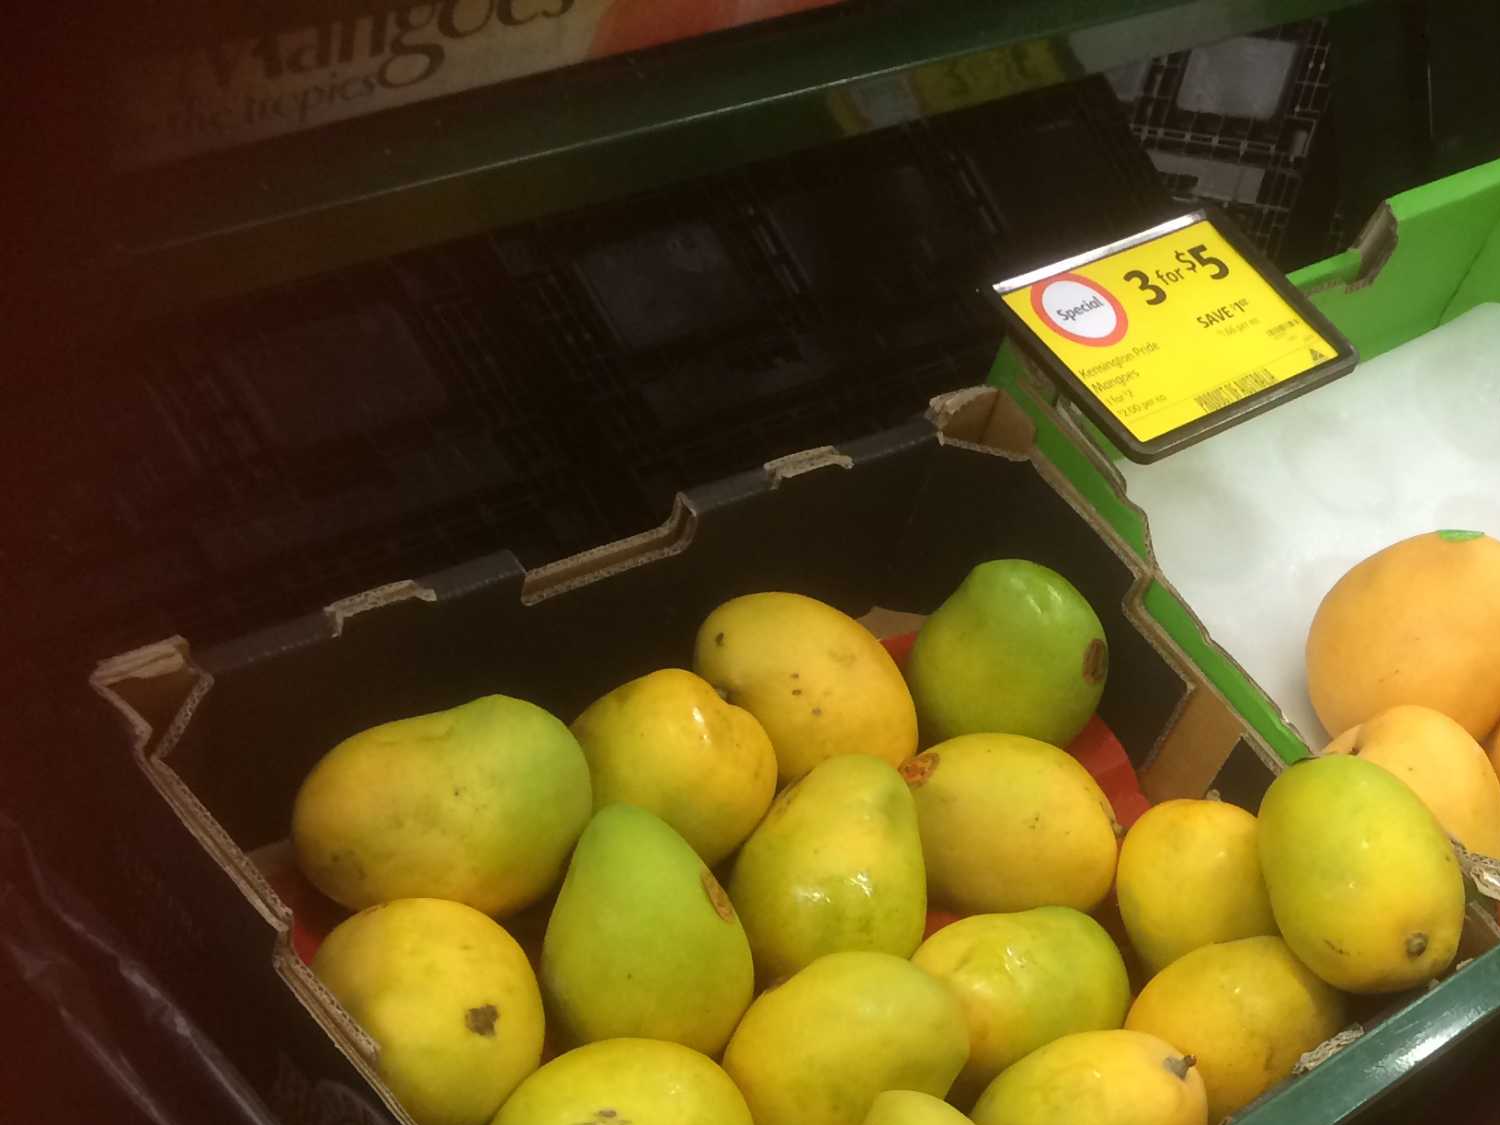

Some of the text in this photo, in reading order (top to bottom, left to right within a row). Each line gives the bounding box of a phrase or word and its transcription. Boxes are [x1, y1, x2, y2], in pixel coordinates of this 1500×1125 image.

[1123, 243, 1230, 306] 3 for $5
[1056, 296, 1104, 321] Special
[1196, 305, 1235, 329] SAVE
[1078, 340, 1161, 379] Kensington Pride
